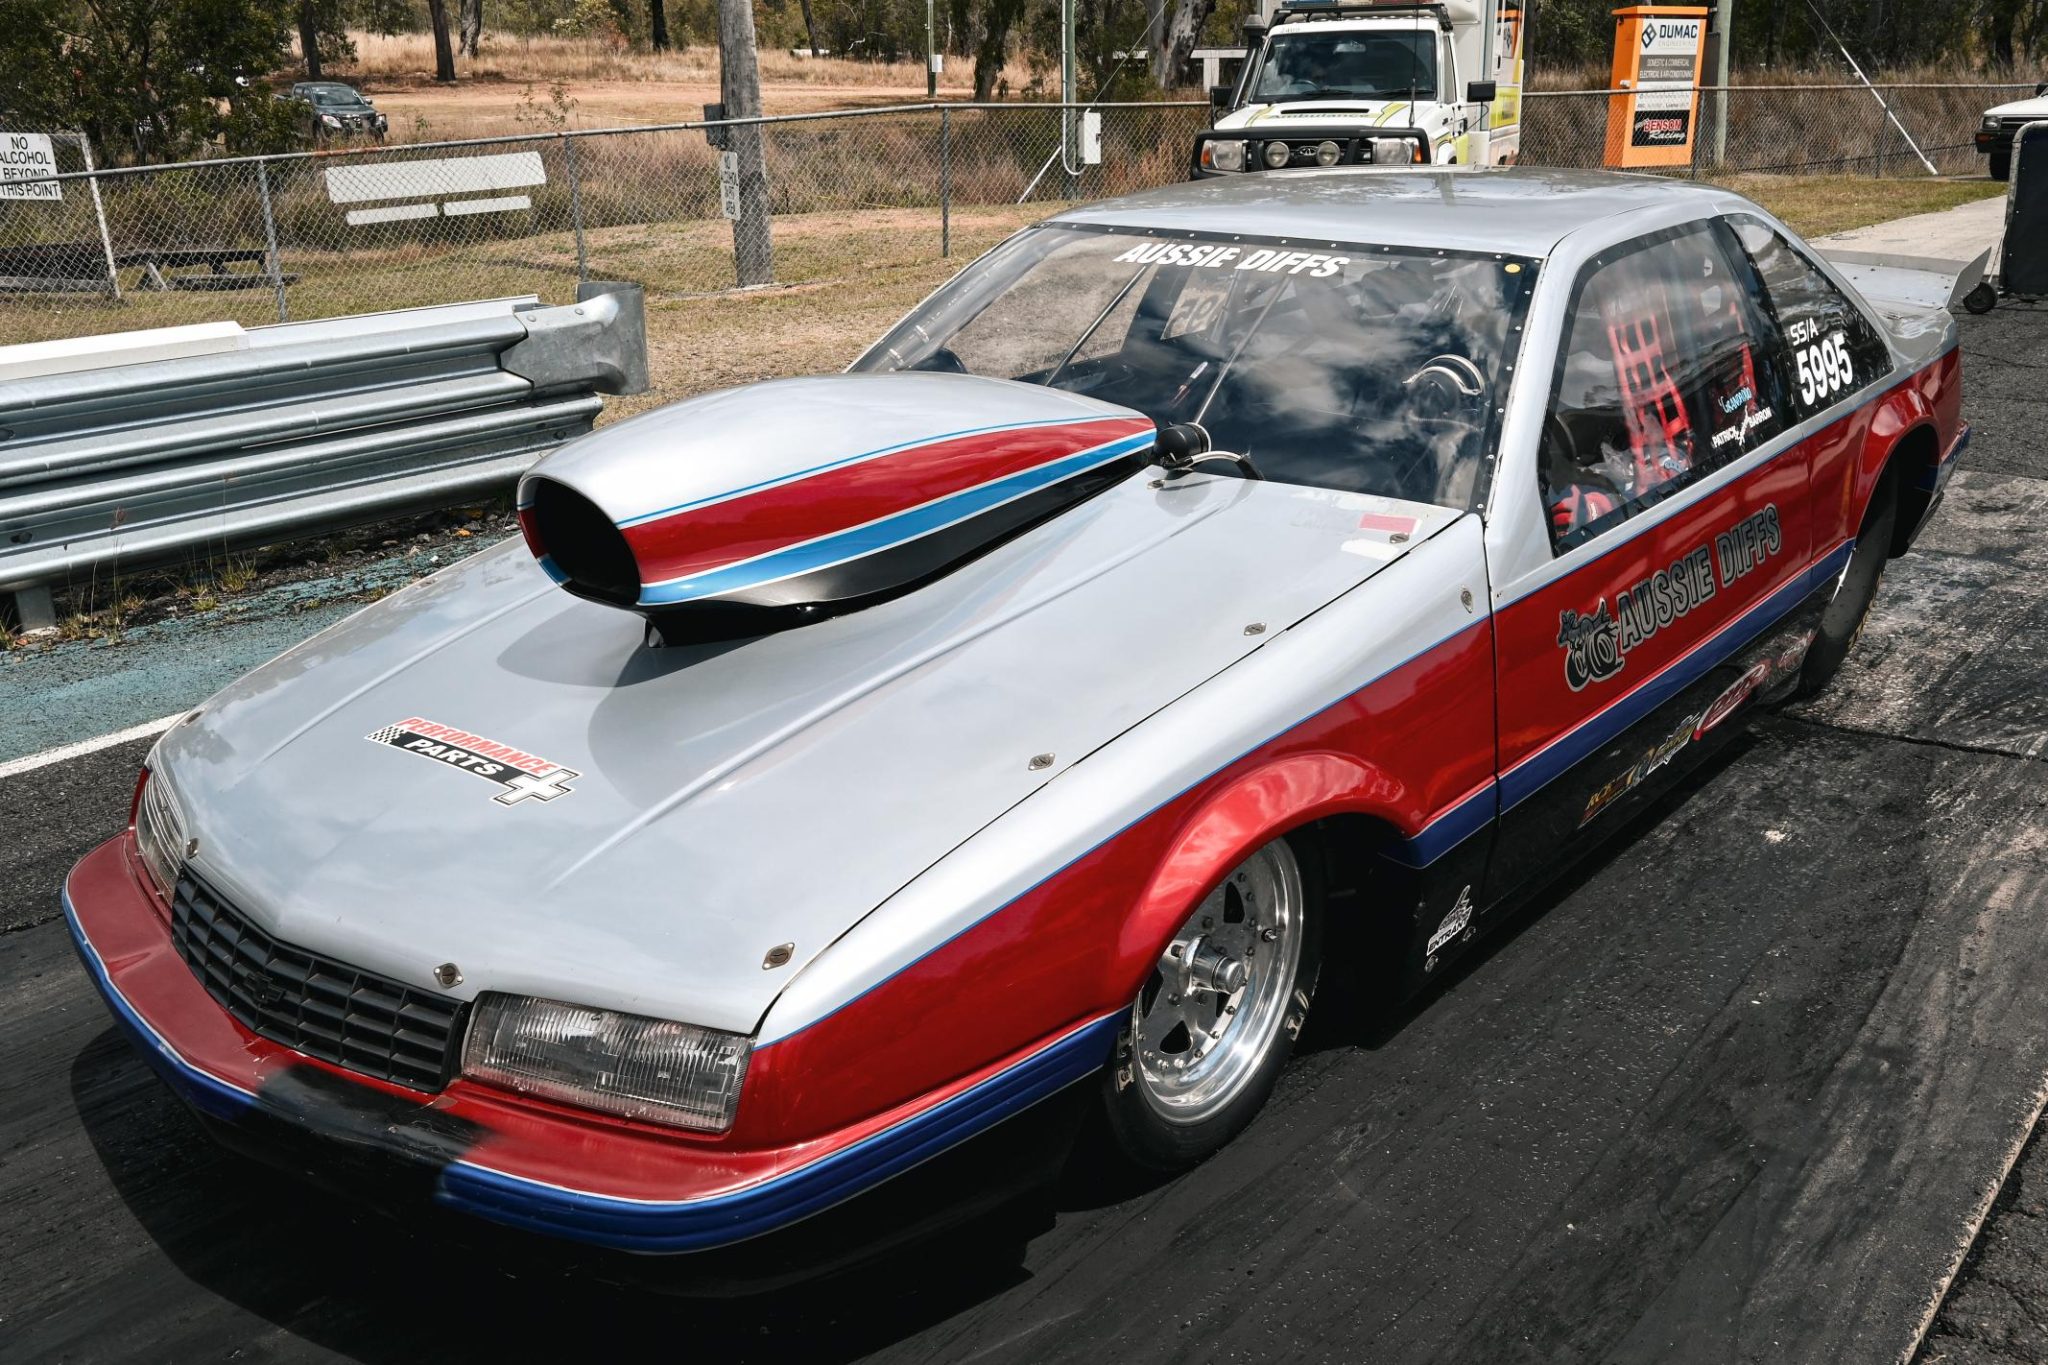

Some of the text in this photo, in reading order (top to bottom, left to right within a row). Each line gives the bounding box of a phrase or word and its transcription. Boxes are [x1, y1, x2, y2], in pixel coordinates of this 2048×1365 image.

[1659, 24, 1698, 38] DUMAC
[1644, 118, 1682, 132] BENSON
[1648, 130, 1686, 142] Racing
[11, 136, 28, 150] NO
[0, 151, 51, 165] ALCOHOL
[1, 183, 59, 197] THIS POINT
[1112, 243, 1351, 278] AUSSIE DIFFS
[1790, 317, 1819, 346] SS/A
[1796, 332, 1853, 406] 5995
[1711, 406, 1773, 449] PATRICK BARRON
[1616, 544, 1715, 654] AUSSIE
[1715, 502, 1782, 588] DIFFS
[395, 716, 558, 774] PERFORMANCE
[404, 738, 504, 777] PARTS
